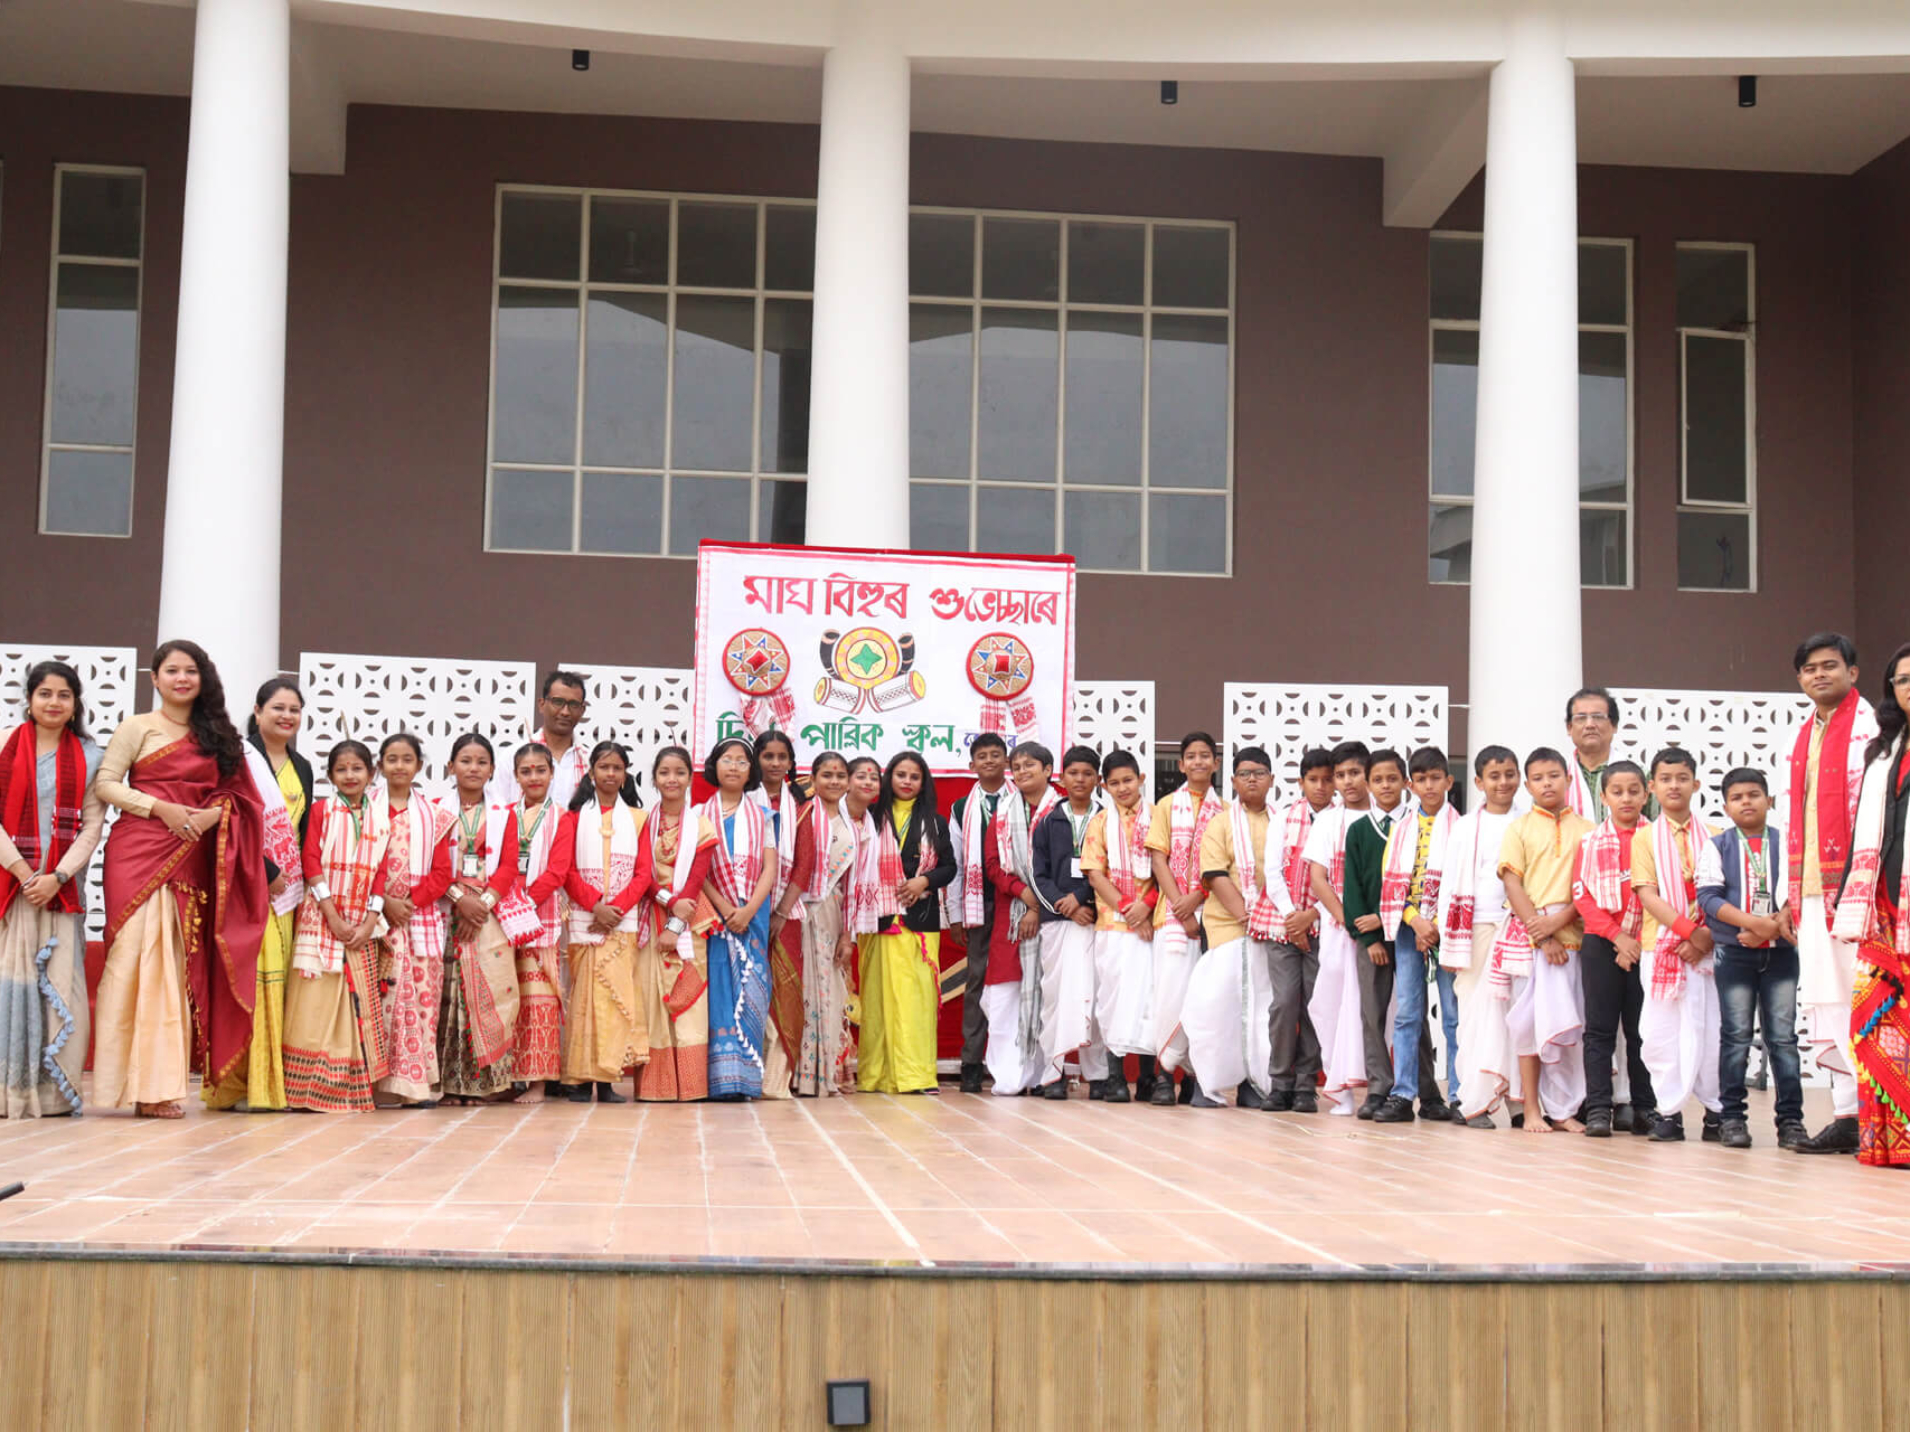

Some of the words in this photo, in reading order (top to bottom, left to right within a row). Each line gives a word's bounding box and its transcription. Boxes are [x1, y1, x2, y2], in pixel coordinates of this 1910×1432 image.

[743, 574, 818, 615] মাঘ
[823, 572, 910, 619] বিহুৰ
[929, 587, 1062, 626] শুভেচ্ছাৰে
[800, 716, 884, 751] পাব্লিক
